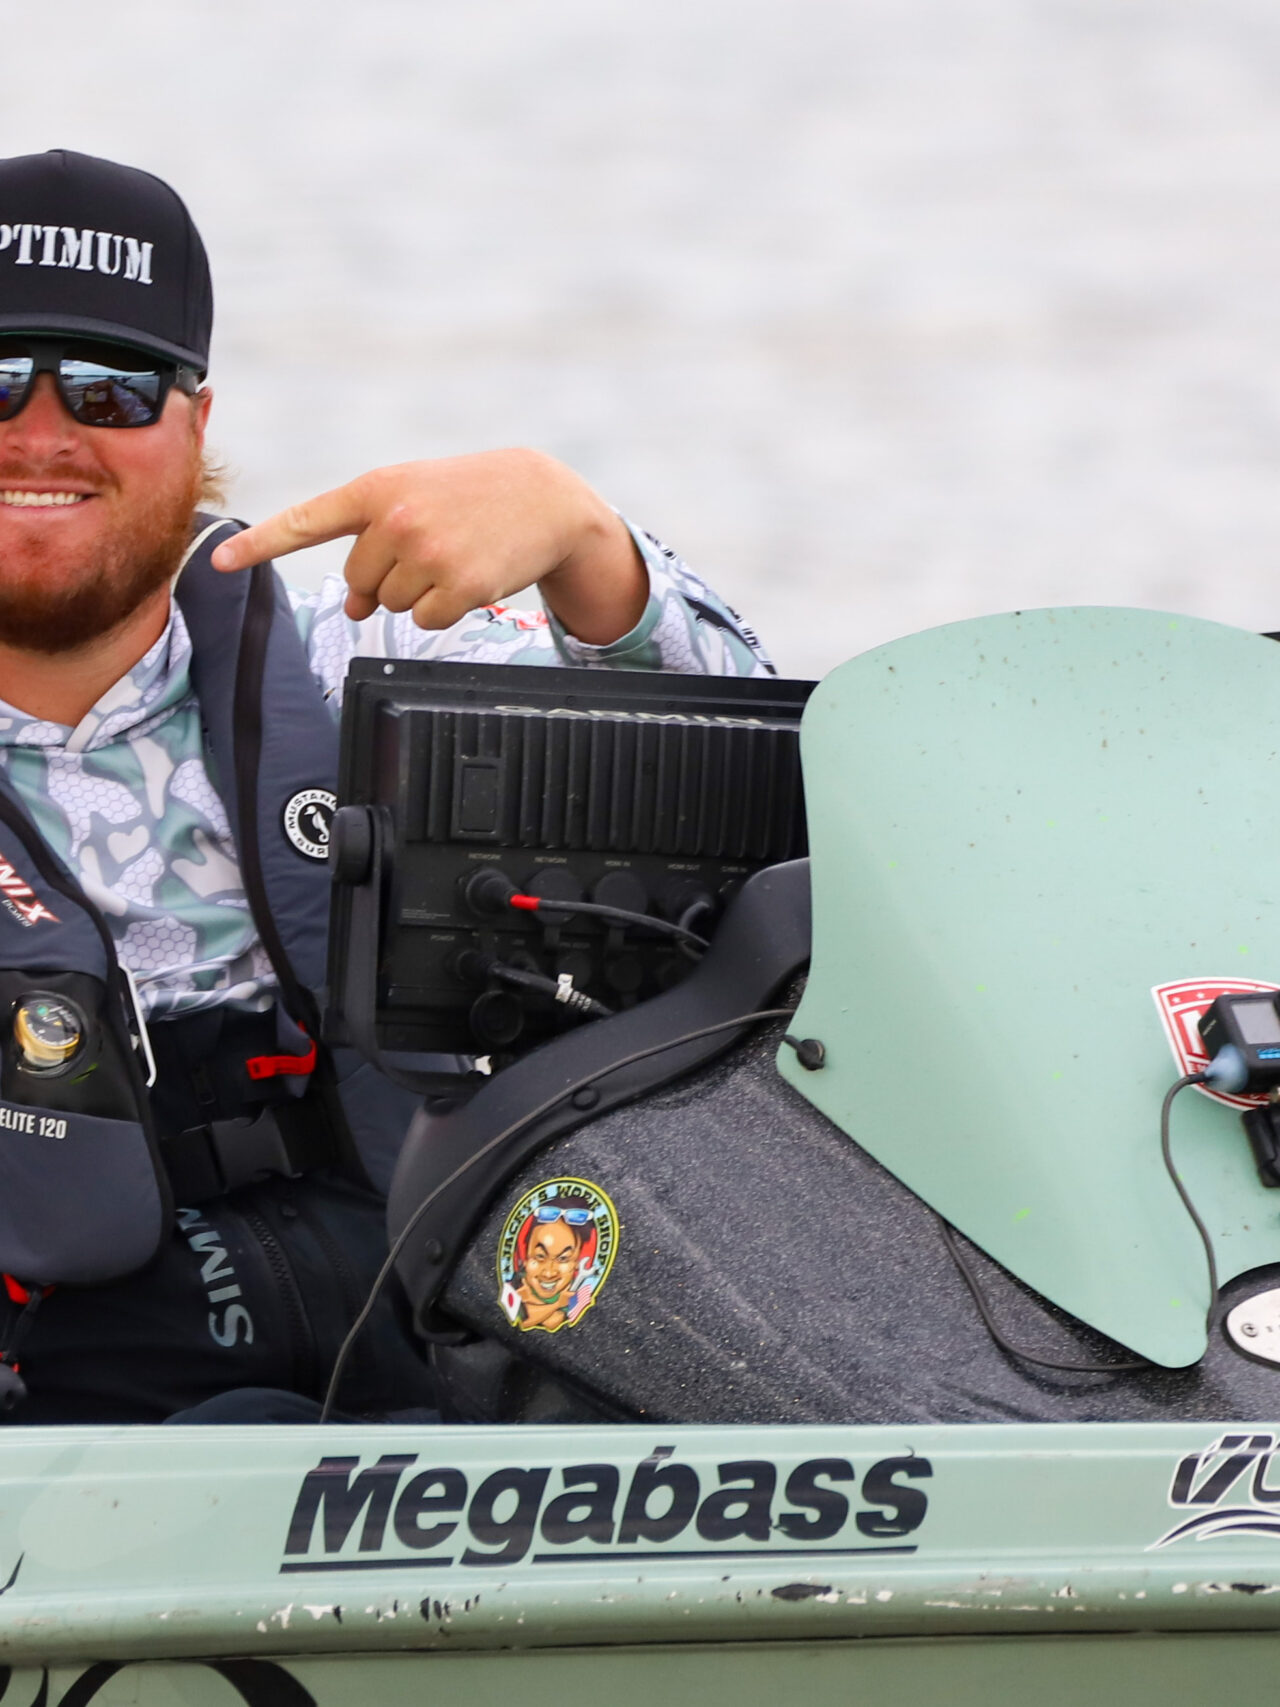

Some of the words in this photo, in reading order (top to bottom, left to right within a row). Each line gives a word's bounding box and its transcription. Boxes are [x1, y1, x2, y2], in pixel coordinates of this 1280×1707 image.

[39, 1117, 67, 1139] 120
[176, 1207, 254, 1347] SIMM
[282, 1446, 934, 1568] Megabass
